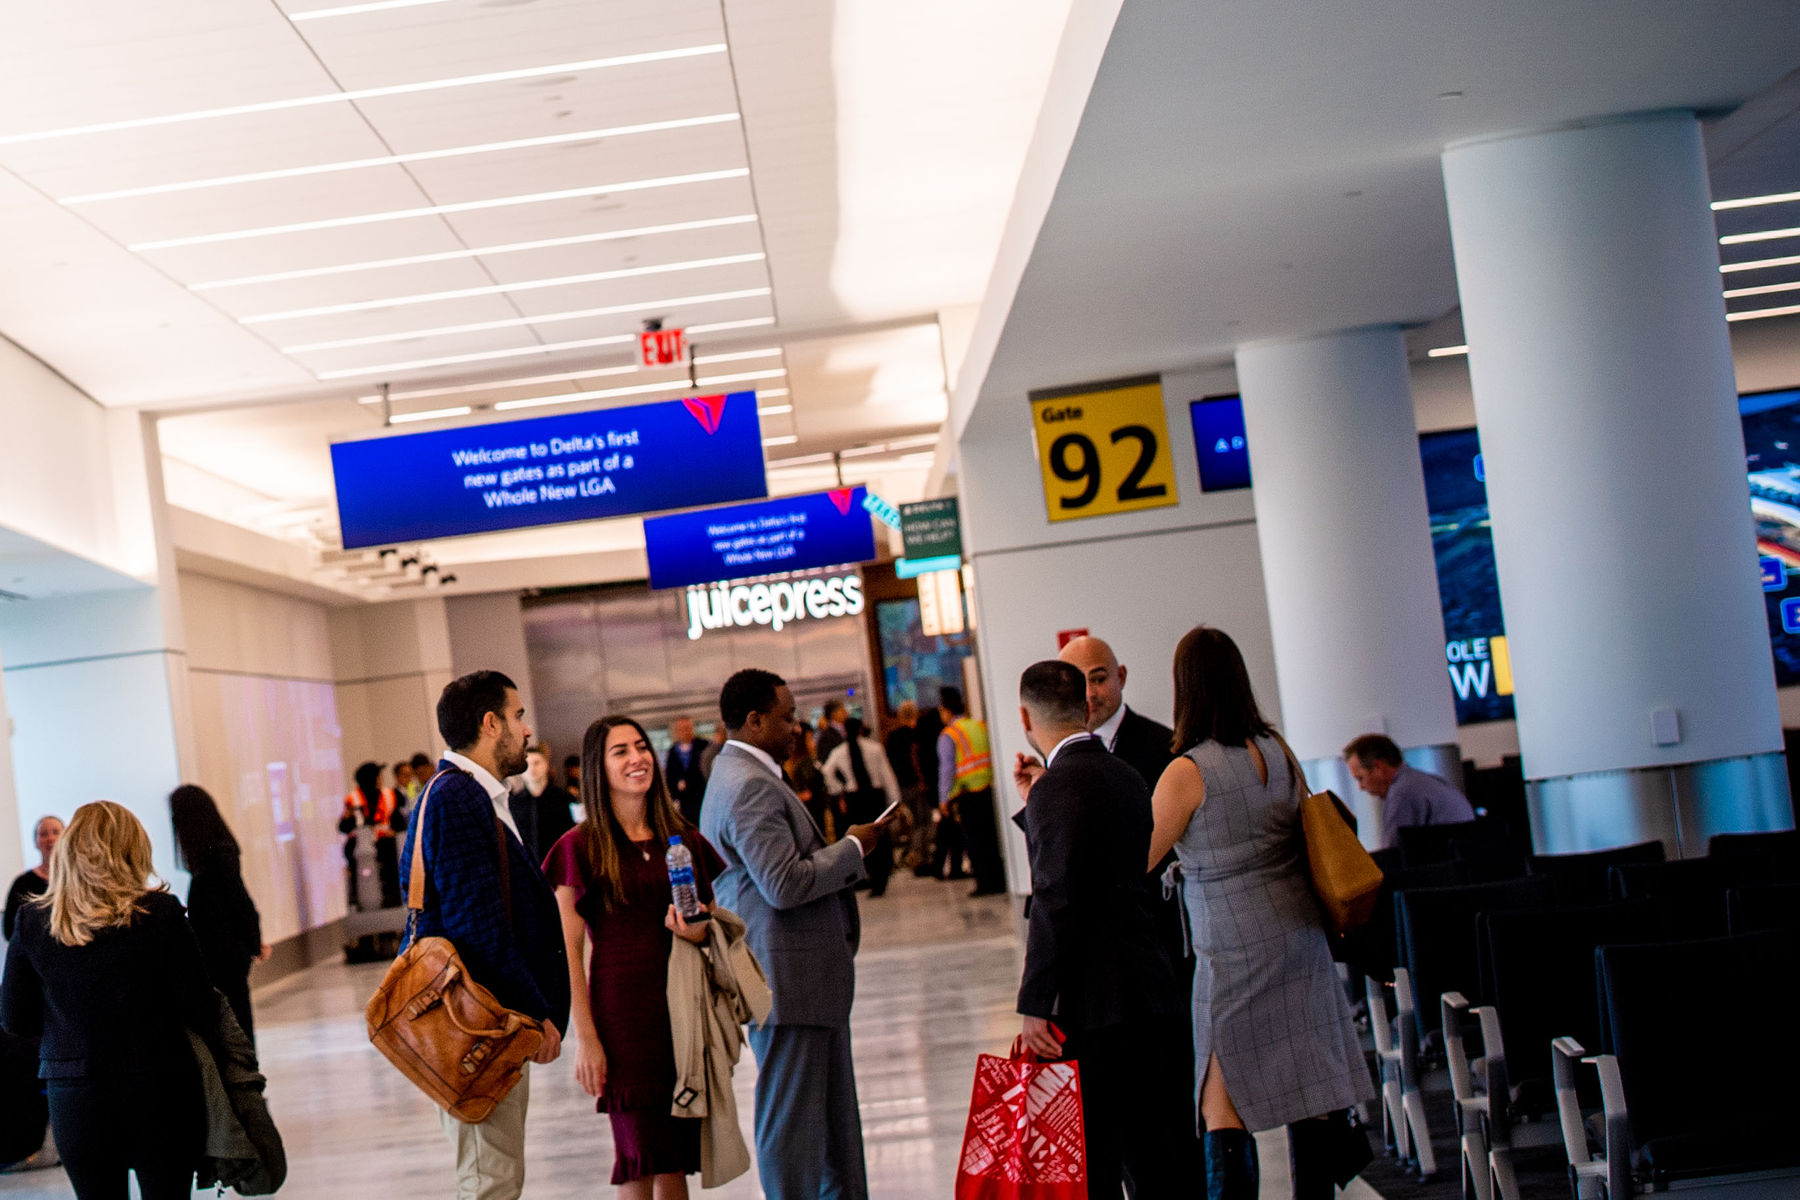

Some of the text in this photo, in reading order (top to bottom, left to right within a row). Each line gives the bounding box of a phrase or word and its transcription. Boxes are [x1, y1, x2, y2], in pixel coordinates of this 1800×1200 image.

[641, 328, 683, 366] EXIT
[1041, 406, 1083, 424] Gate
[452, 429, 640, 467] Welcome to Delta's first
[463, 452, 634, 489] new gates as part of a
[1050, 424, 1167, 510] 92
[483, 476, 617, 508] Whole New LGA
[687, 574, 865, 640] juicepress
[1445, 637, 1490, 662] OLE
